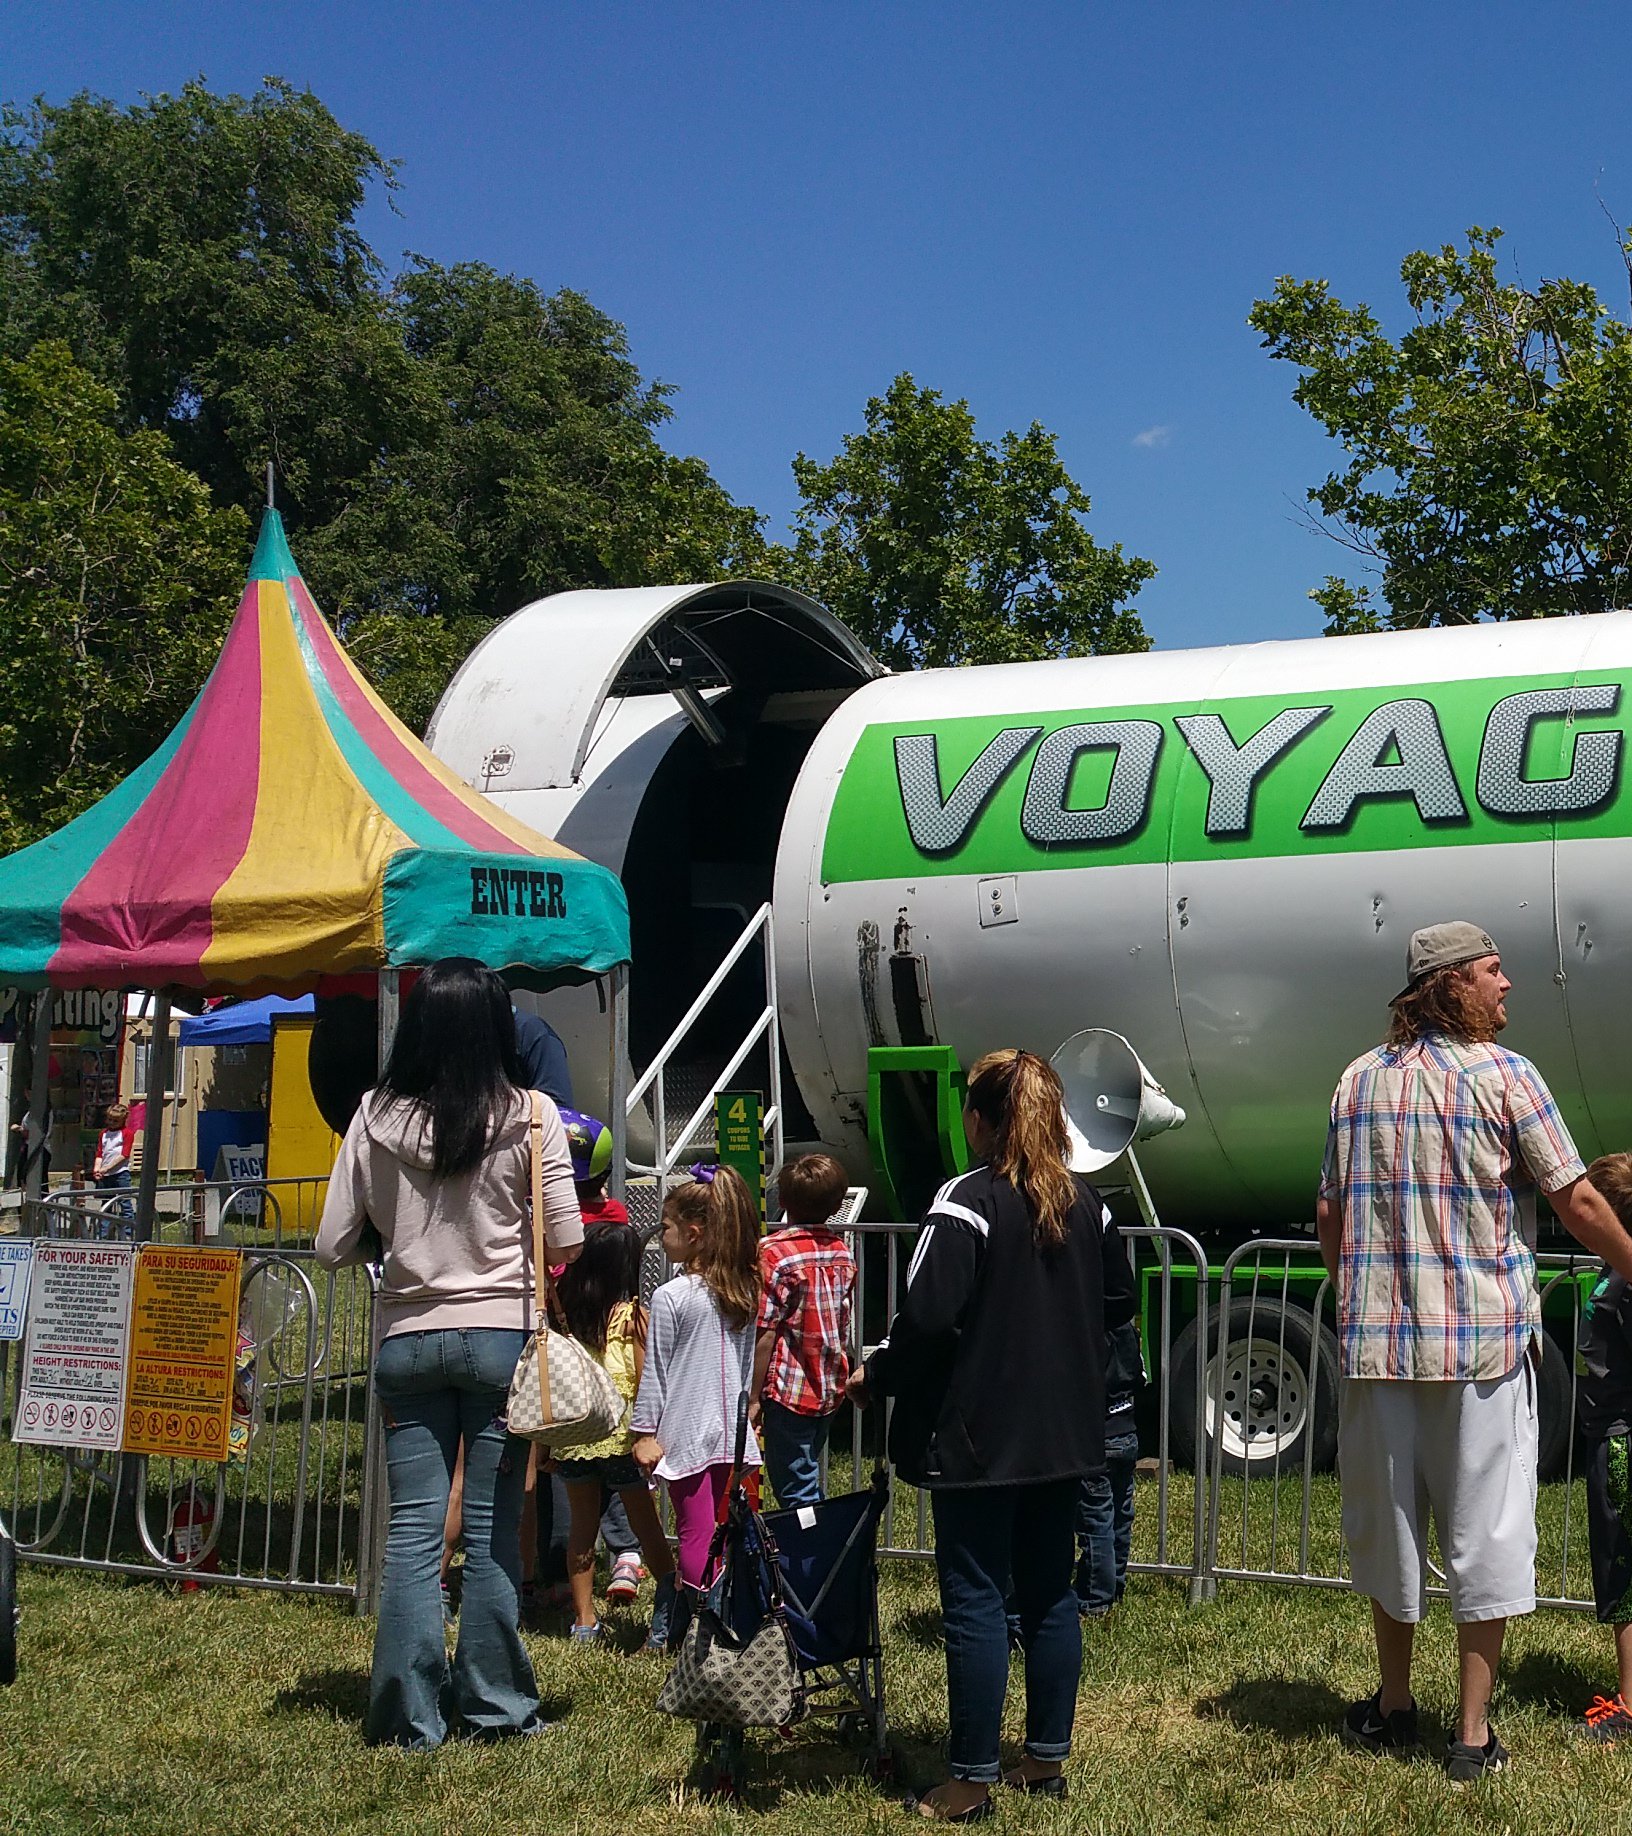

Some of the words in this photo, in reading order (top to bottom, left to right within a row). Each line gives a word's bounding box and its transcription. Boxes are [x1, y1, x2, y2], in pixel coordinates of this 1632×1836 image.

[469, 867, 567, 919] ENTER
[728, 1098, 747, 1123] 4
[727, 1126, 751, 1134] COUPONS
[7, 1247, 30, 1261] TAKES
[38, 1250, 57, 1263] FOR
[60, 1251, 87, 1264] YOUR
[89, 1252, 129, 1267] SAFETY:
[141, 1254, 163, 1268] PARA
[165, 1256, 176, 1269] SU
[33, 1356, 62, 1368] HEIGHT
[63, 1358, 122, 1371] RESTRICTIONS:
[136, 1363, 145, 1373] LA
[146, 1364, 172, 1376] ALTURA
[173, 1367, 226, 1380] RESTRICTIONS:
